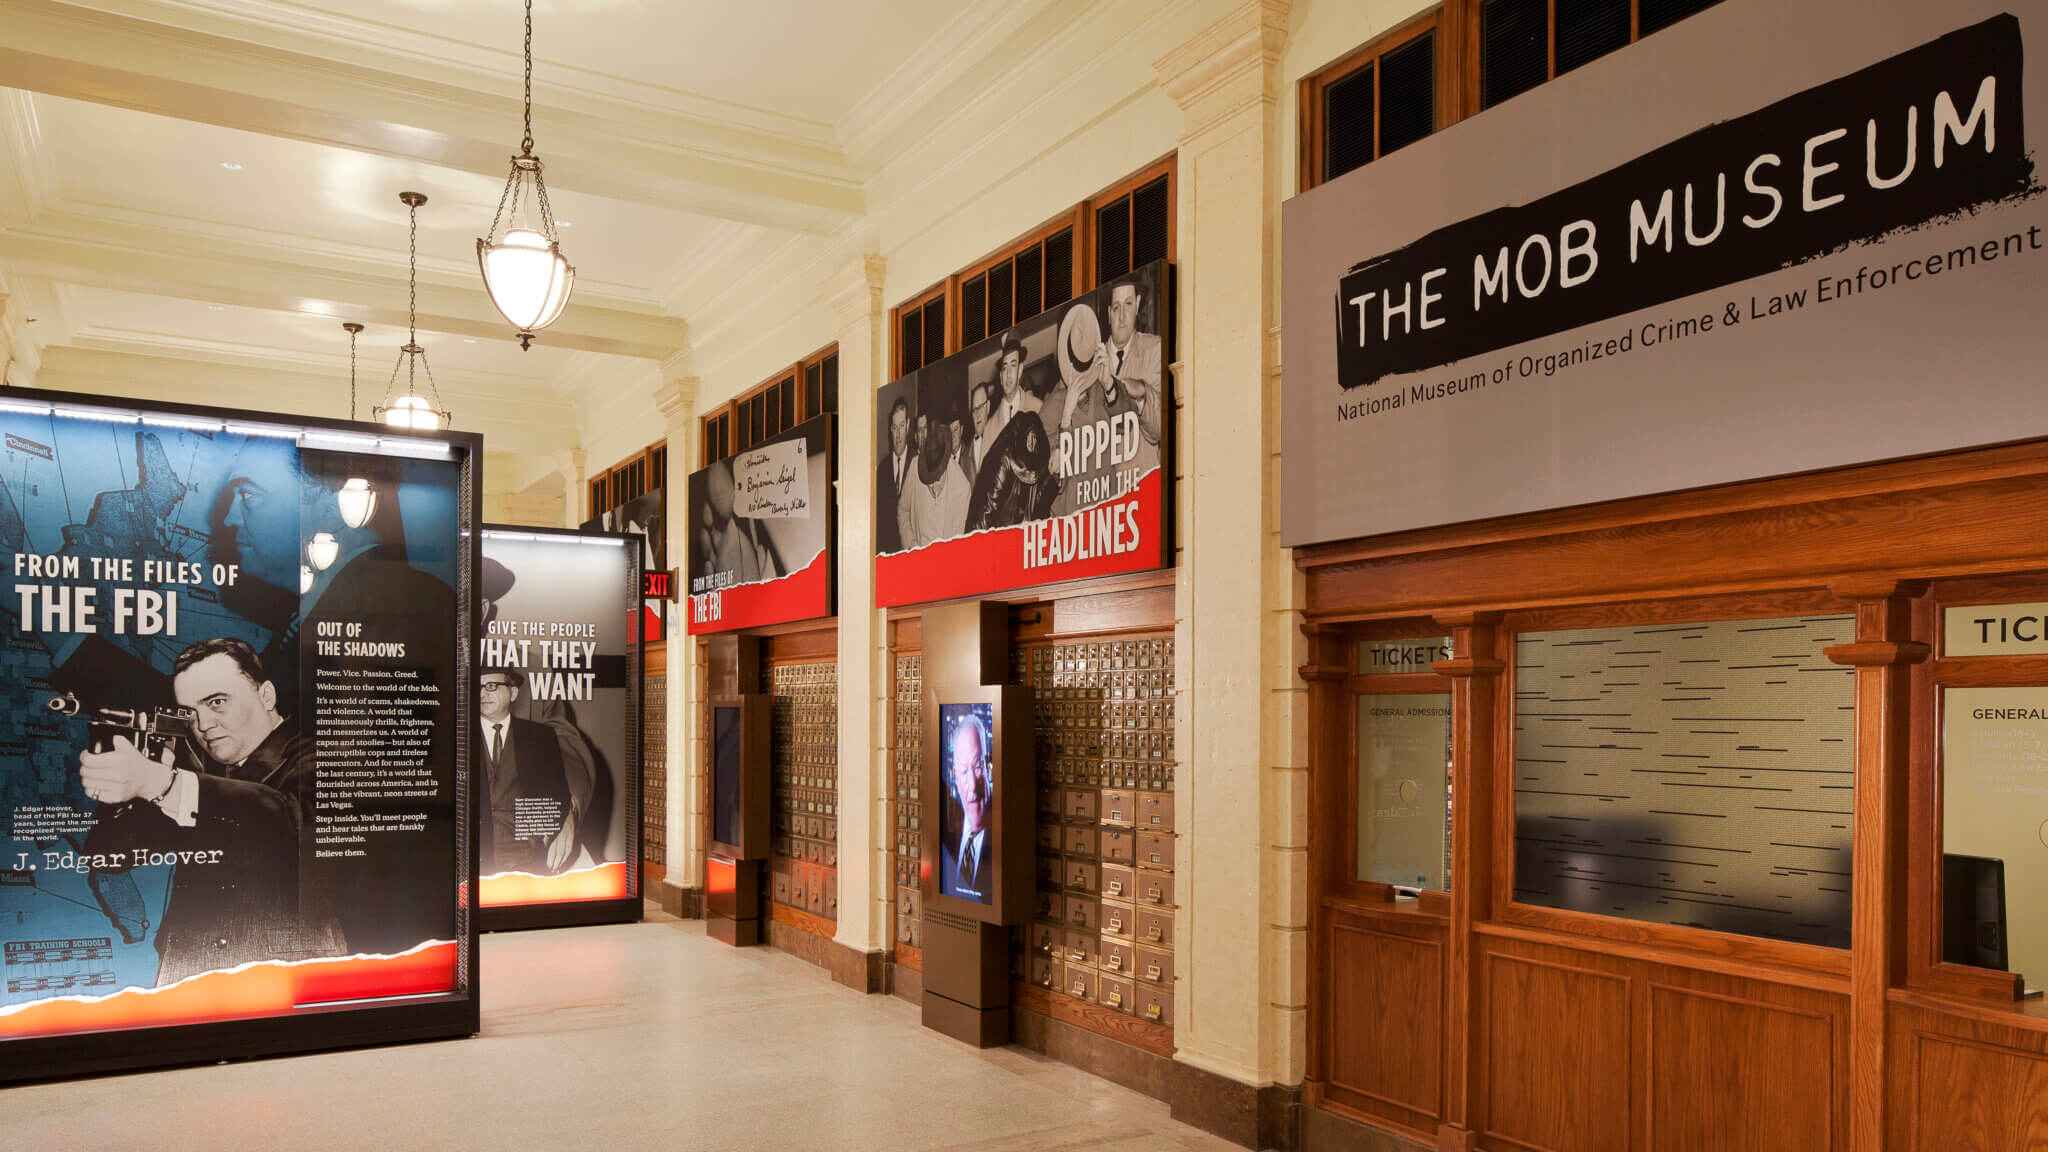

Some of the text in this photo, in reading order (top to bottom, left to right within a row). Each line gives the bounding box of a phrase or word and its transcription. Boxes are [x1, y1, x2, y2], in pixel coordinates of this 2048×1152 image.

[1349, 75, 1996, 347] THE MOB MUSEUM
[1338, 225, 2042, 422] National Museum of Organized Crime & Law Enforcement
[1060, 411, 1140, 478] RIPPED
[1077, 467, 1140, 504] FROM THE
[1023, 500, 1140, 569] HEADLINES
[14, 553, 239, 587] FROM THE FILES OF
[693, 569, 734, 592] FROM THE FILES OF
[15, 584, 177, 636] THE FBI
[694, 591, 721, 624] THE FBI
[317, 621, 362, 638] OUT OF
[487, 620, 596, 638] GIVE THE PEOPLE
[317, 641, 405, 658] THE SHADOWS
[540, 640, 597, 670] THEY
[1370, 646, 1449, 666] TICKETS
[317, 669, 419, 679] Power. Vice. Passion. Greed.
[316, 683, 352, 691] Welcome
[376, 684, 398, 692] world
[398, 684, 407, 692] of
[408, 684, 420, 692] the
[528, 672, 596, 701] WANT
[335, 697, 357, 705] world
[358, 697, 367, 705] of
[394, 697, 440, 706] shakedowns,
[1370, 708, 1404, 717] GENERAL
[1972, 708, 2048, 720] GENERAL
[316, 718, 435, 727] simultaneously thrills, frightens,
[316, 749, 366, 757] incorruptible
[367, 750, 386, 758] cops
[316, 760, 363, 768] prosecutors.
[364, 759, 380, 767] And
[345, 770, 376, 778] century,
[316, 780, 355, 788] flourished
[353, 790, 382, 798] vibrant,
[316, 801, 354, 810] Las Vegas.
[316, 815, 333, 823] Step
[402, 813, 428, 822] people
[332, 825, 349, 833] hear
[399, 823, 425, 832] frankly
[316, 835, 366, 844] unbelievable.
[316, 849, 367, 858] Believe them.
[13, 849, 224, 874] J. Edgar Hoover
